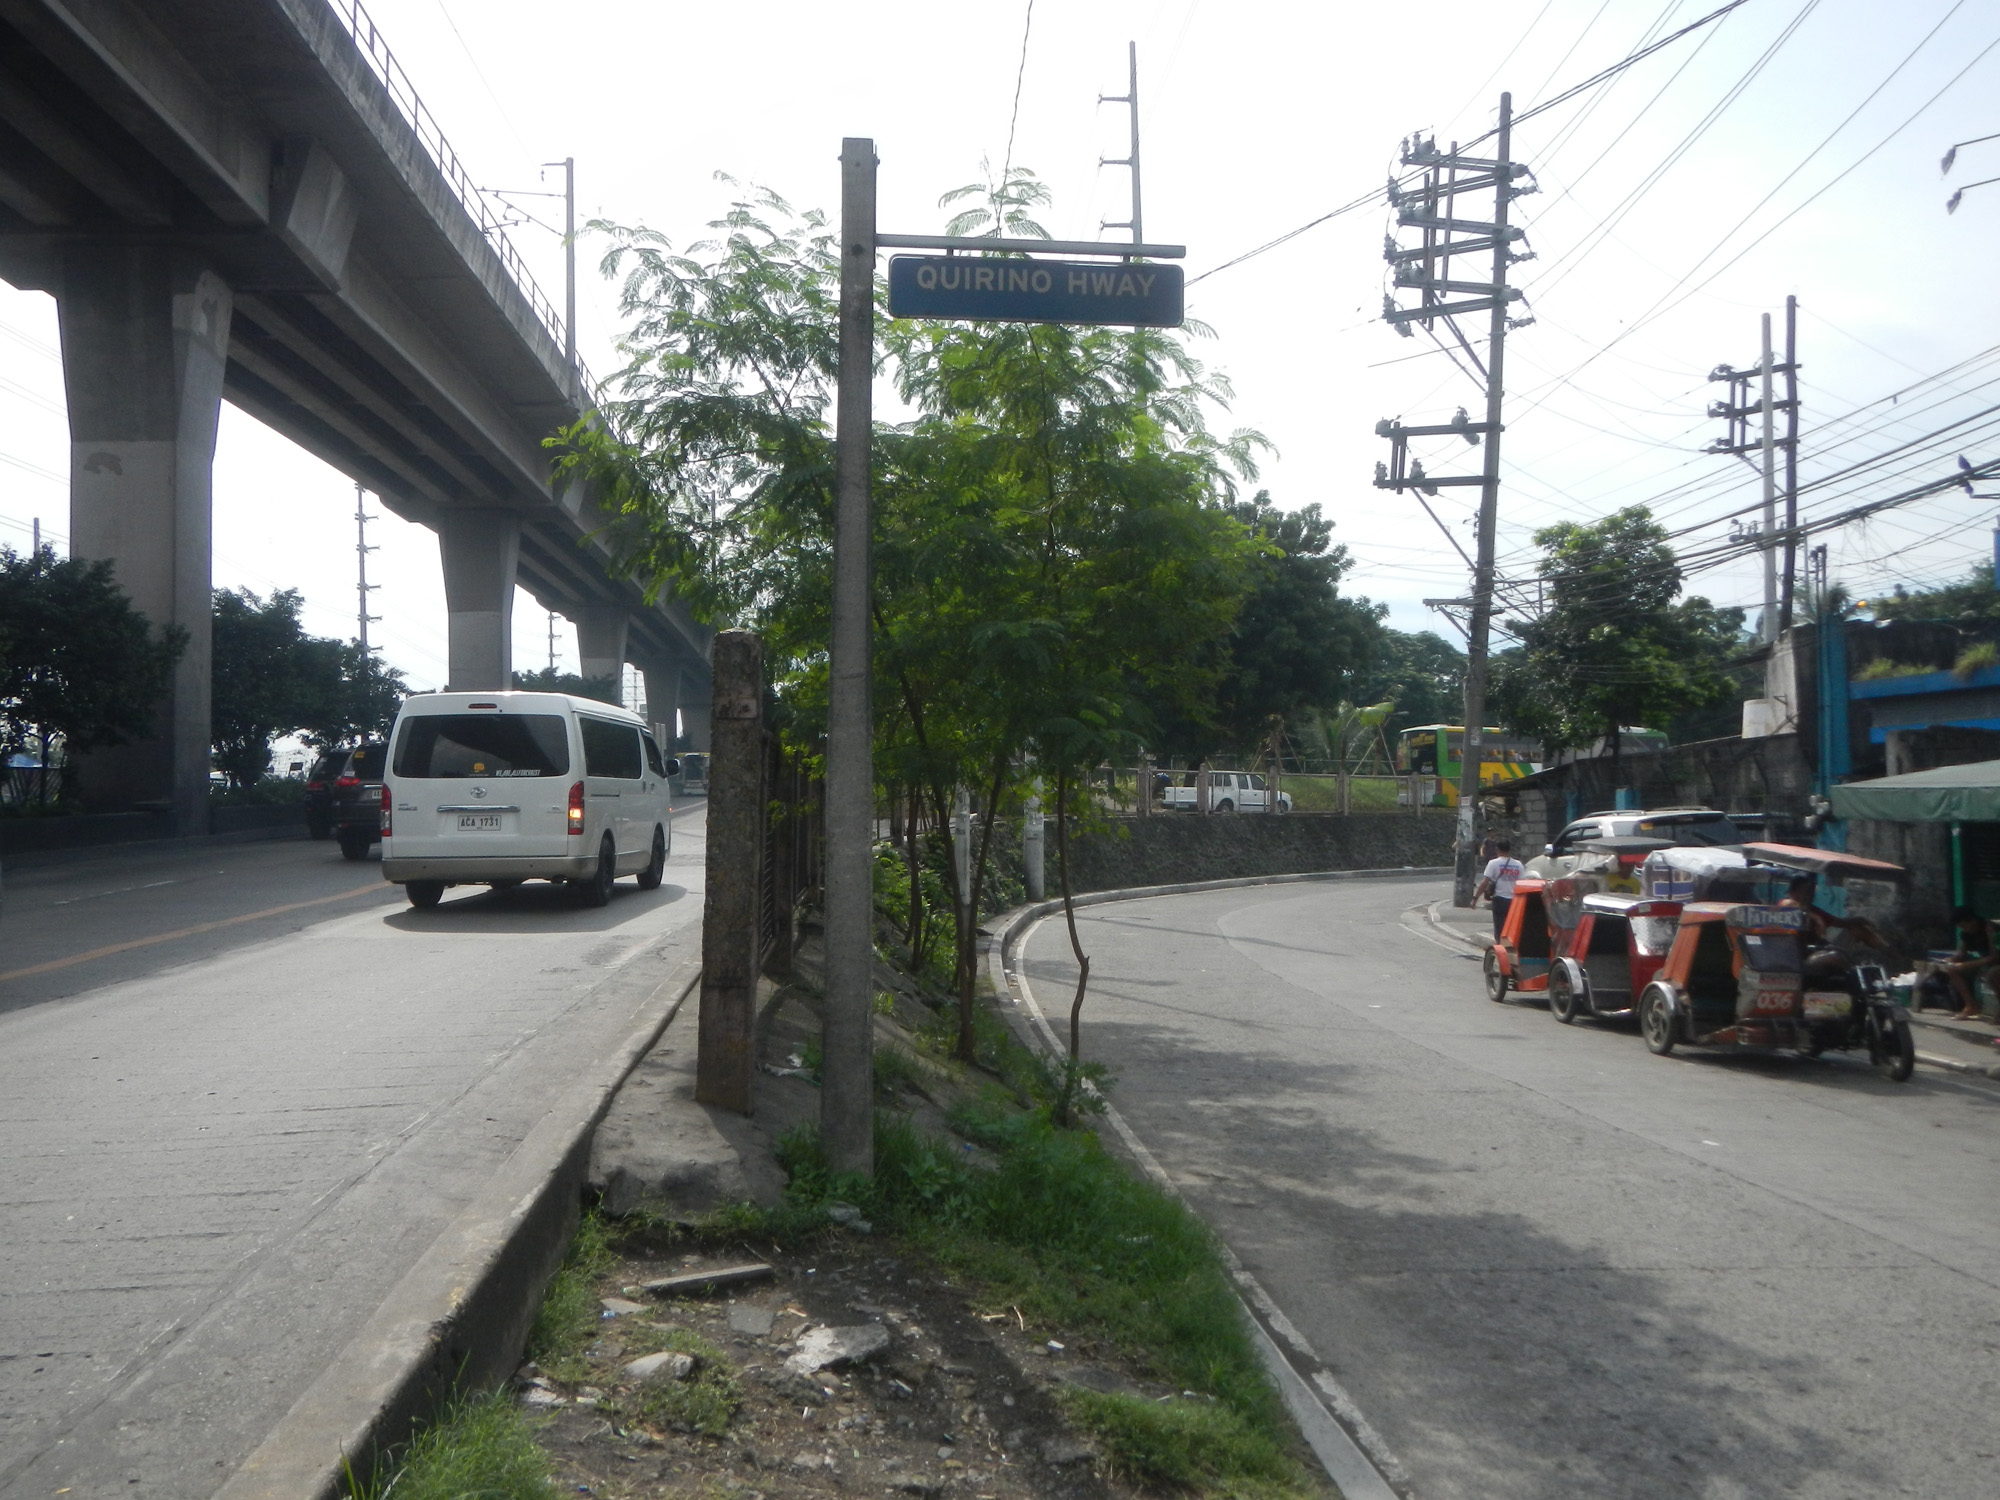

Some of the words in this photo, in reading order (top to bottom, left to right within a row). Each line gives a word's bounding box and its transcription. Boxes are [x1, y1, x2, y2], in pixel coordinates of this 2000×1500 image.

[916, 265, 1051, 293] QUIRINO
[1067, 271, 1157, 297] HWAY
[1757, 992, 1793, 1009] 036
